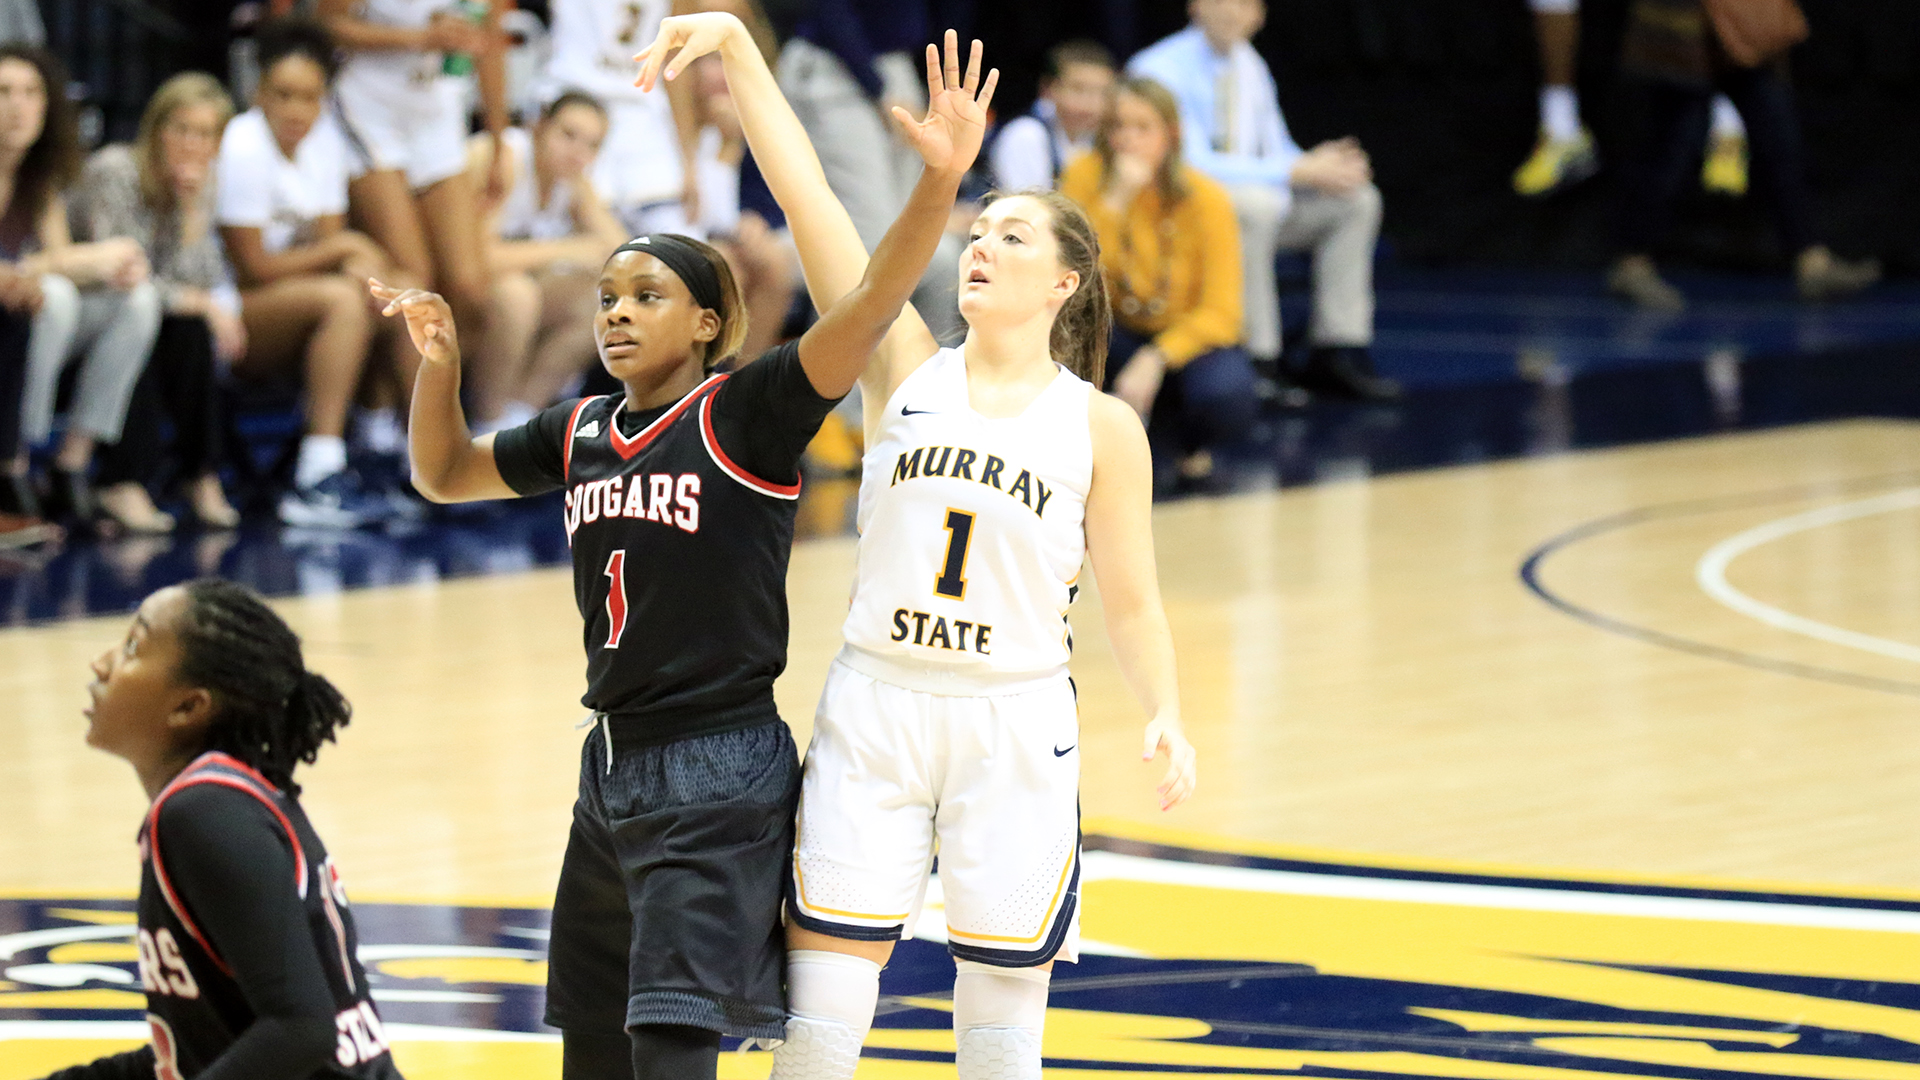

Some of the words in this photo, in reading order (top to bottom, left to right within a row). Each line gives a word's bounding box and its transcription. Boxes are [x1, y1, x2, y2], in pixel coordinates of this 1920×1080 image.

[890, 446, 1053, 520] MURRAY
[932, 506, 977, 602] 1
[603, 549, 629, 650] 1
[890, 607, 993, 656] STATE
